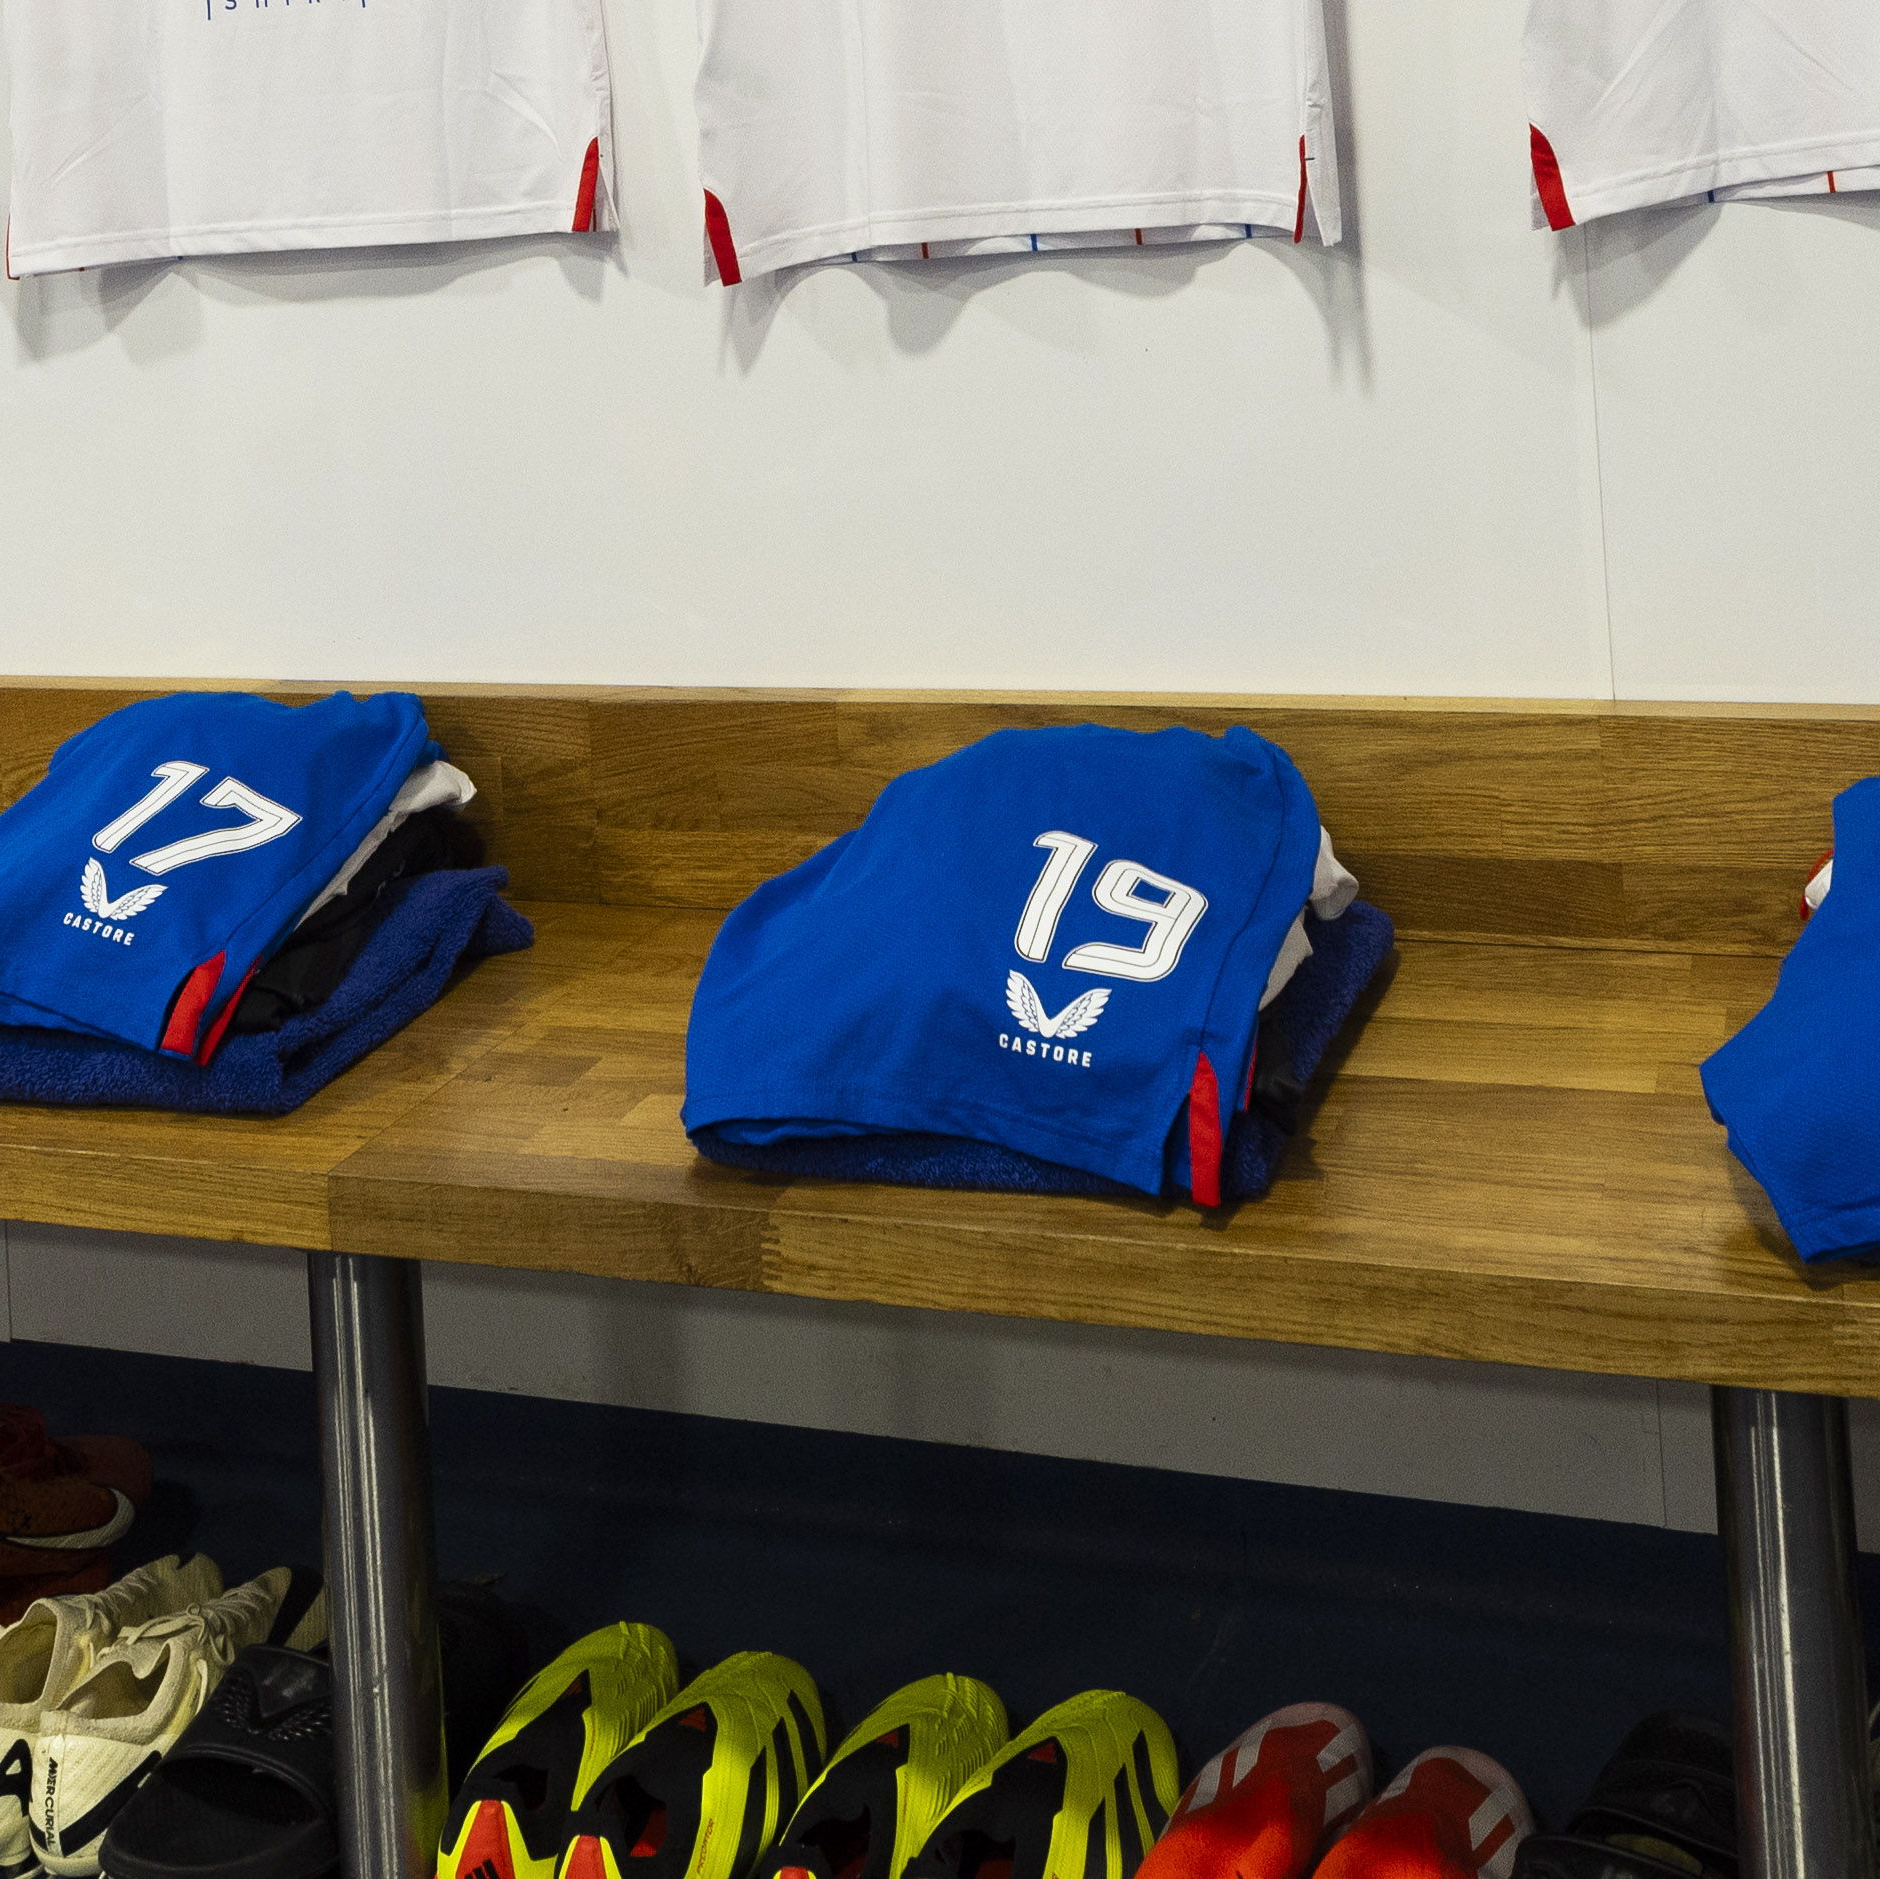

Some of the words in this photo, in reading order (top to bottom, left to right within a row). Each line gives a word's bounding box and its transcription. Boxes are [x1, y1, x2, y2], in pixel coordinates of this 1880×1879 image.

[91, 760, 303, 876] 17
[63, 912, 135, 947] CASTORE
[1014, 830, 1209, 983] 19
[998, 1033, 1093, 1068] CASTORE
[44, 1757, 59, 1847] MERCURIAL
